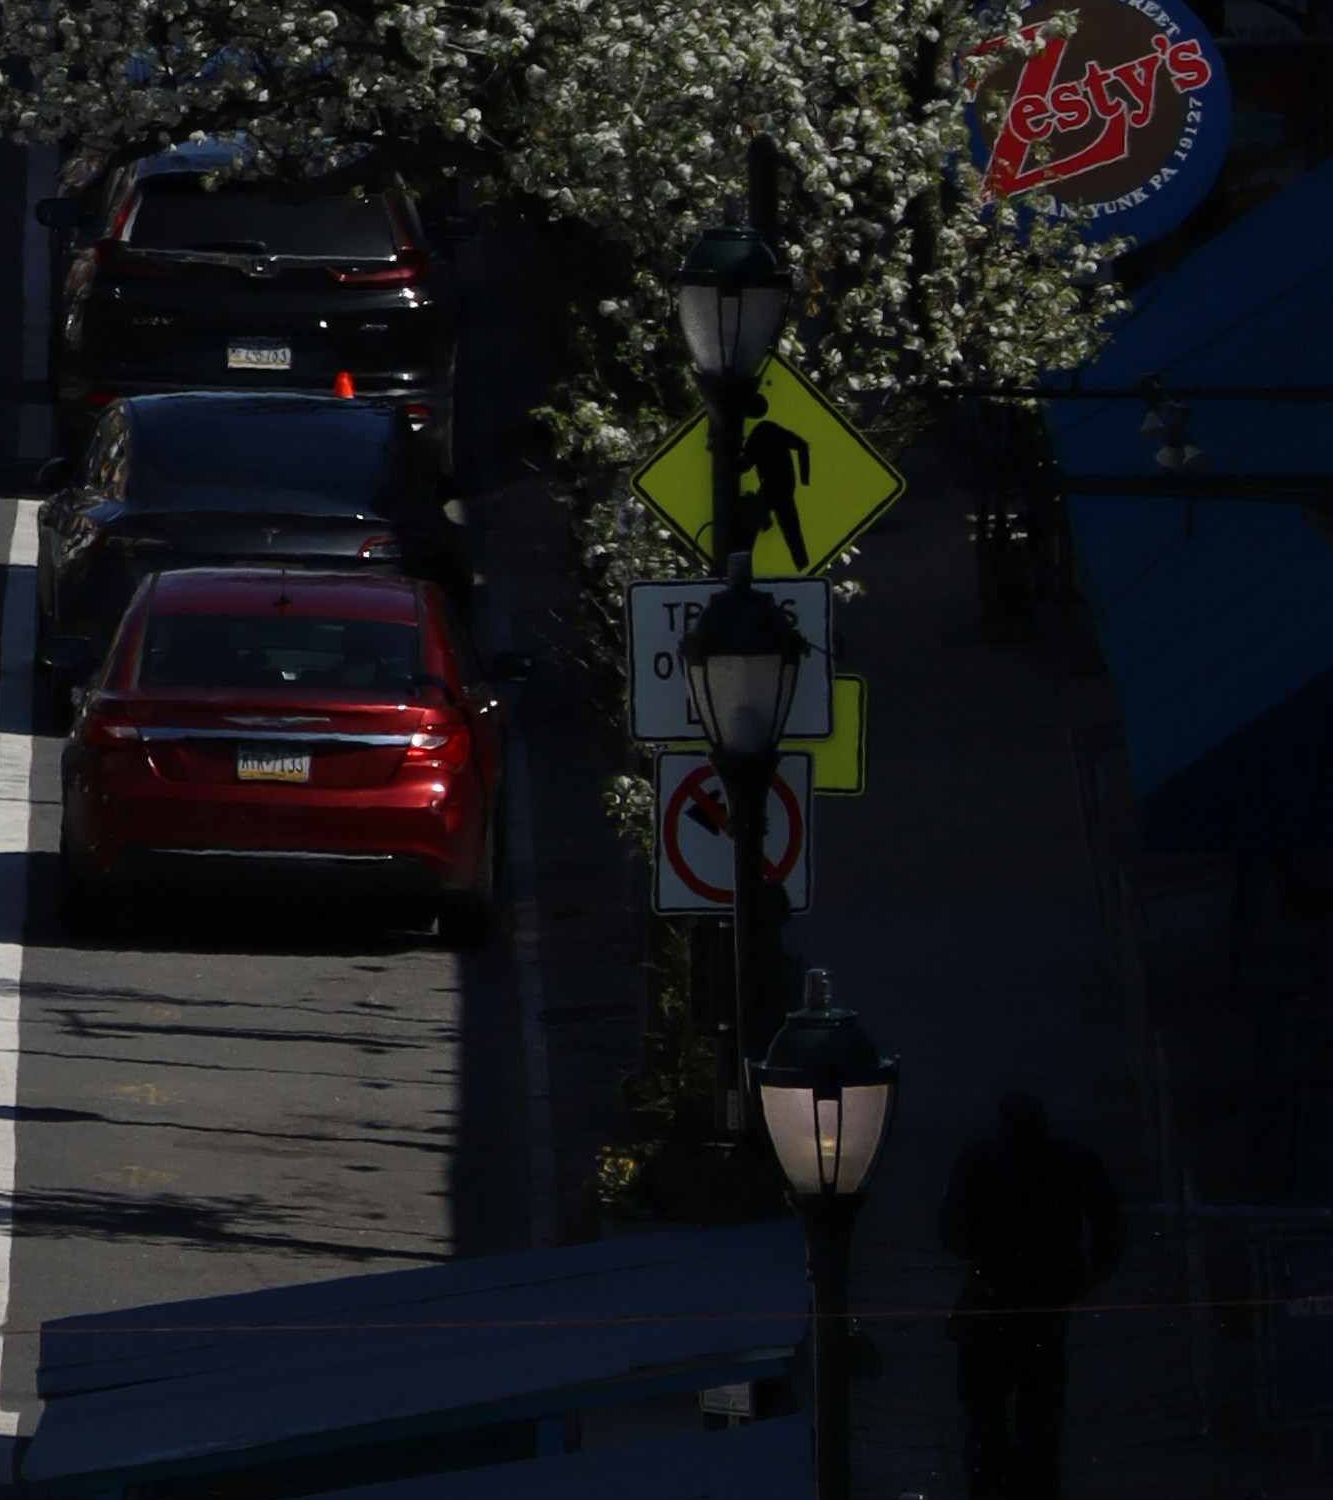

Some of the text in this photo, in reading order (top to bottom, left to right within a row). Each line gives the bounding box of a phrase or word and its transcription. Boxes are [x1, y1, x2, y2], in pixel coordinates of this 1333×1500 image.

[960, 8, 1212, 205] Zesty's
[1148, 167, 1178, 190] PA
[1174, 96, 1203, 162] 19127
